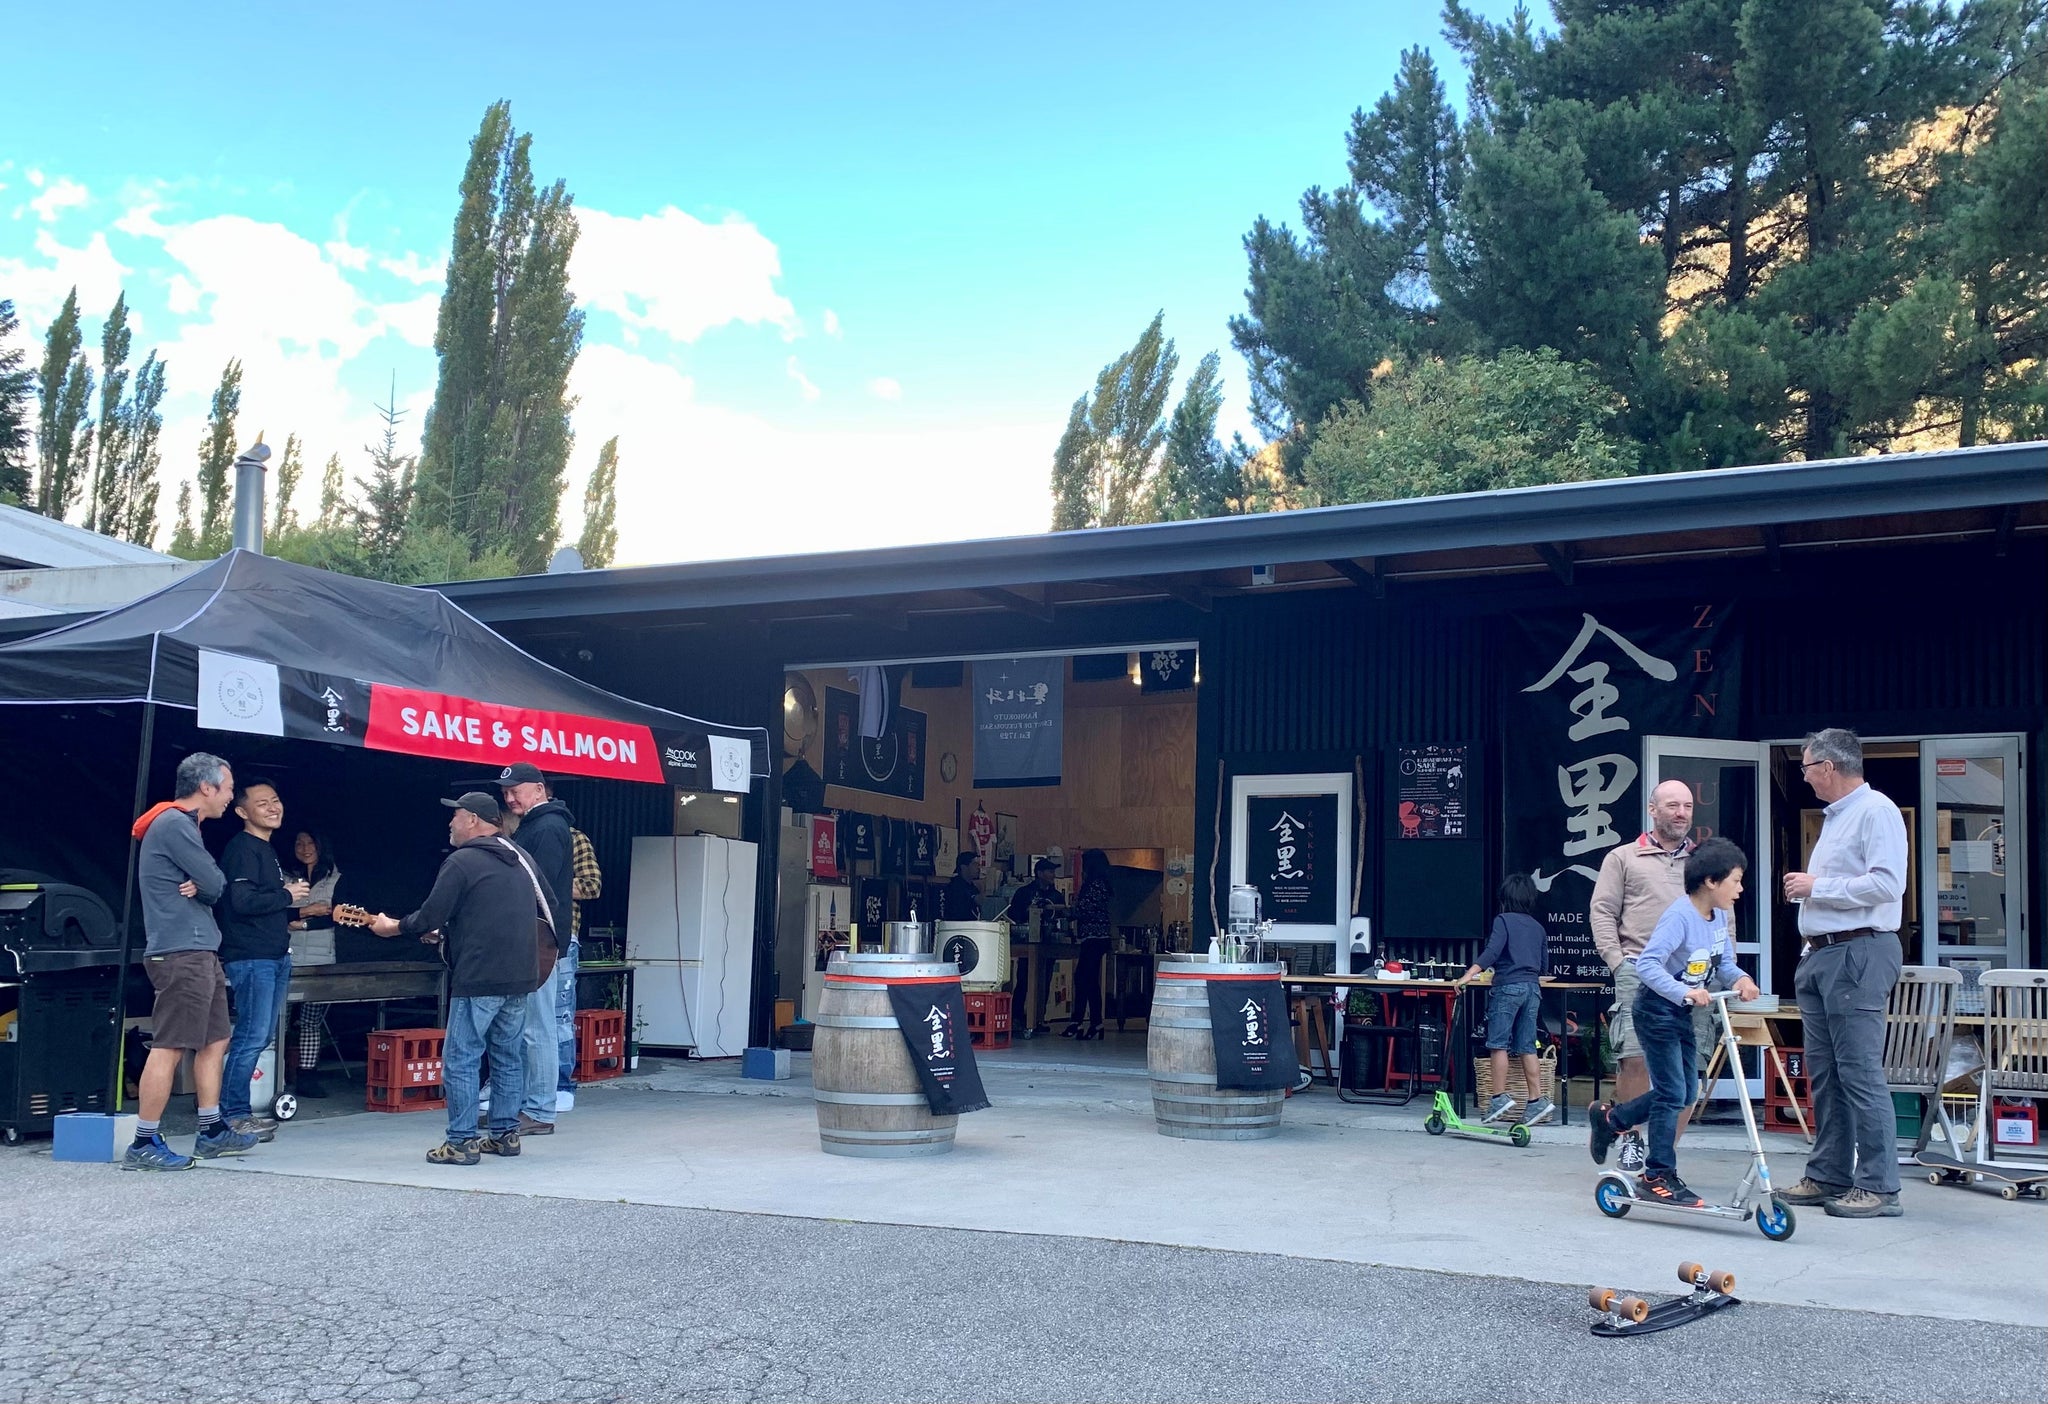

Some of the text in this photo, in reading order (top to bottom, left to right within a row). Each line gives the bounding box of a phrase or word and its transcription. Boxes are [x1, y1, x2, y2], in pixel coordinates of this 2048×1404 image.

[400, 707, 637, 764] SAKE & SALMON
[674, 749, 697, 761] COOK
[1268, 810, 1306, 881] 全黒
[1548, 912, 1584, 923] MADE
[1546, 933, 1590, 942] and made
[1547, 945, 1566, 954] with
[1553, 965, 1571, 975] NZ
[1576, 965, 1611, 977] 純米酒
[1239, 997, 1264, 1046] 全黒
[923, 1004, 950, 1061] 全黒
